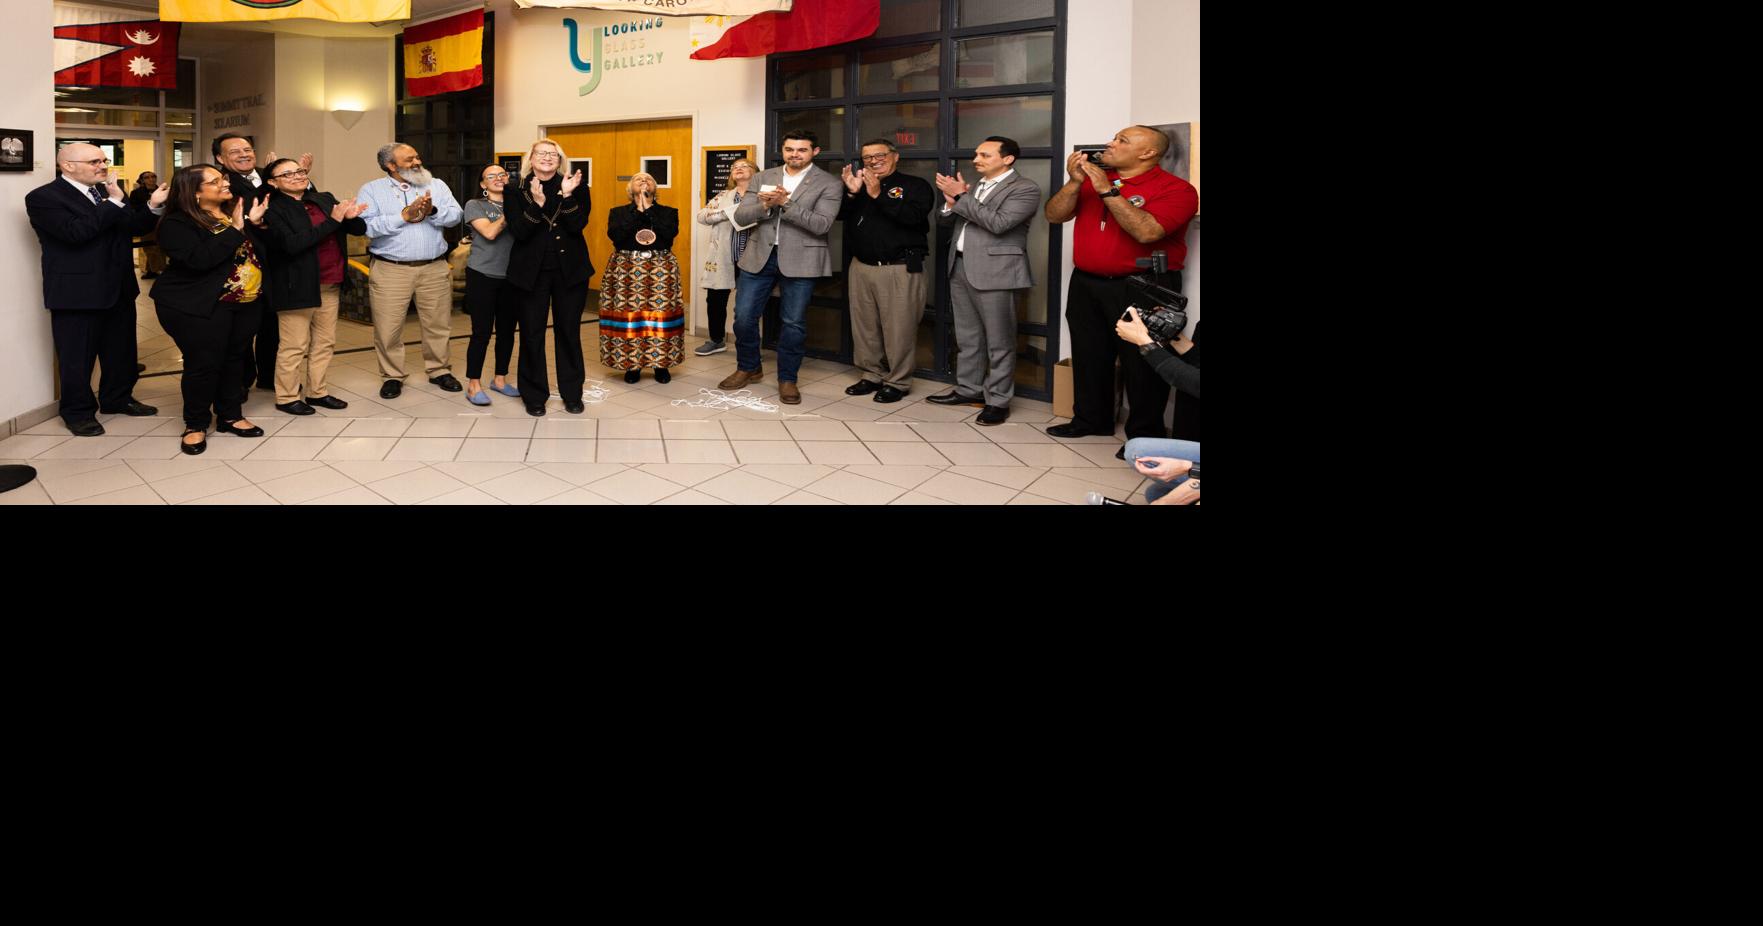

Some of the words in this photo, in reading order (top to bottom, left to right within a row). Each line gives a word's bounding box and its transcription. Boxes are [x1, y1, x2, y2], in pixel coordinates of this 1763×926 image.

[604, 17, 663, 37] LOOKING
[604, 38, 645, 54] GLASS
[604, 52, 664, 71] GALLERY
